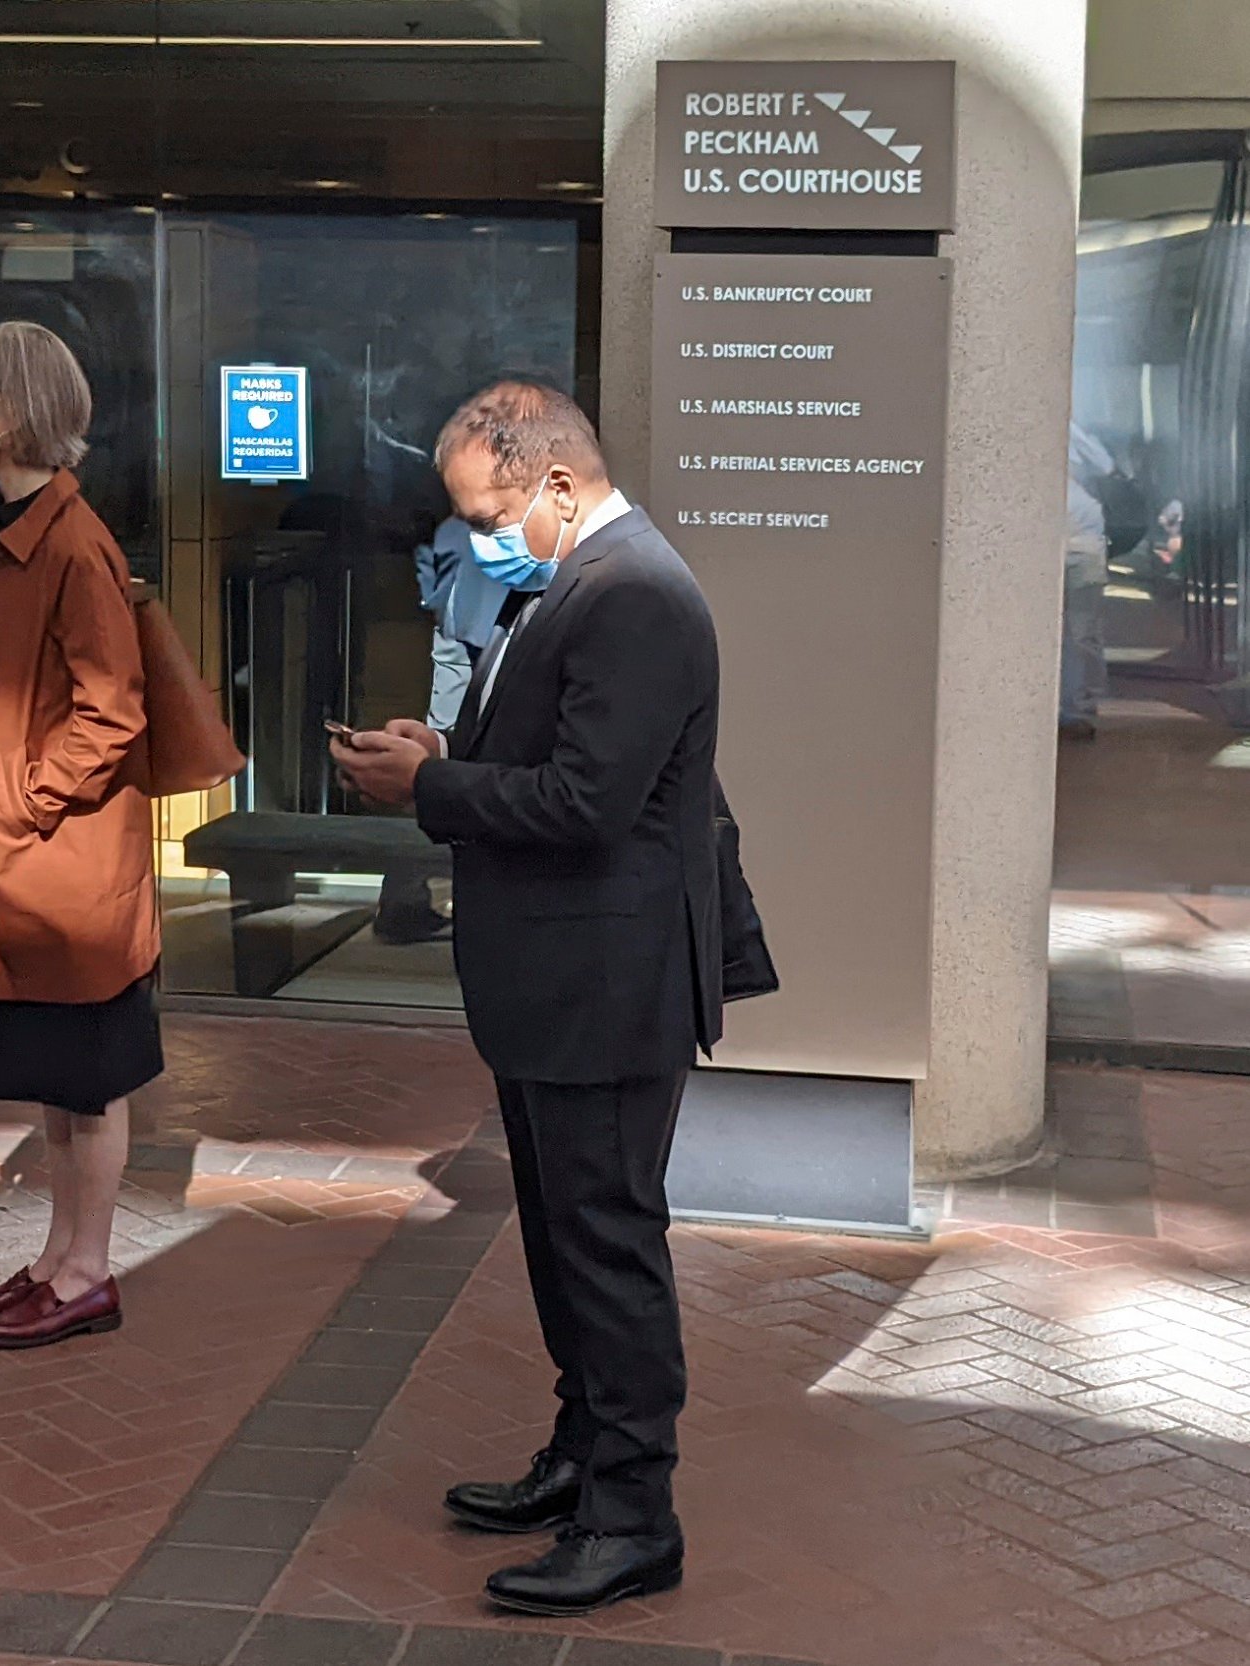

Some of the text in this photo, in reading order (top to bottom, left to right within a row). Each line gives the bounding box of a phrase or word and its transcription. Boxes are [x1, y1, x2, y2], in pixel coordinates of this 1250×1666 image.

[685, 93, 811, 116] ROBERT F.
[685, 130, 819, 154] PECKHAM
[684, 168, 922, 194] U.S. COURTHOUSE
[681, 286, 873, 303] U.S. BANKRUPTCY COURT
[680, 343, 834, 360] U.S. DISTRICT COURT
[240, 378, 282, 389] MASKS
[232, 390, 293, 402] REQUIRED
[680, 399, 861, 417] U.S. MARSHALS SERVICE
[232, 437, 293, 446] MASCARILLAS
[233, 447, 293, 457] REQUERIDAS
[678, 455, 924, 474] U.S. PRETRIAL SERVICES AGENCY
[678, 510, 830, 528] U.S. SECRET SERVICE
